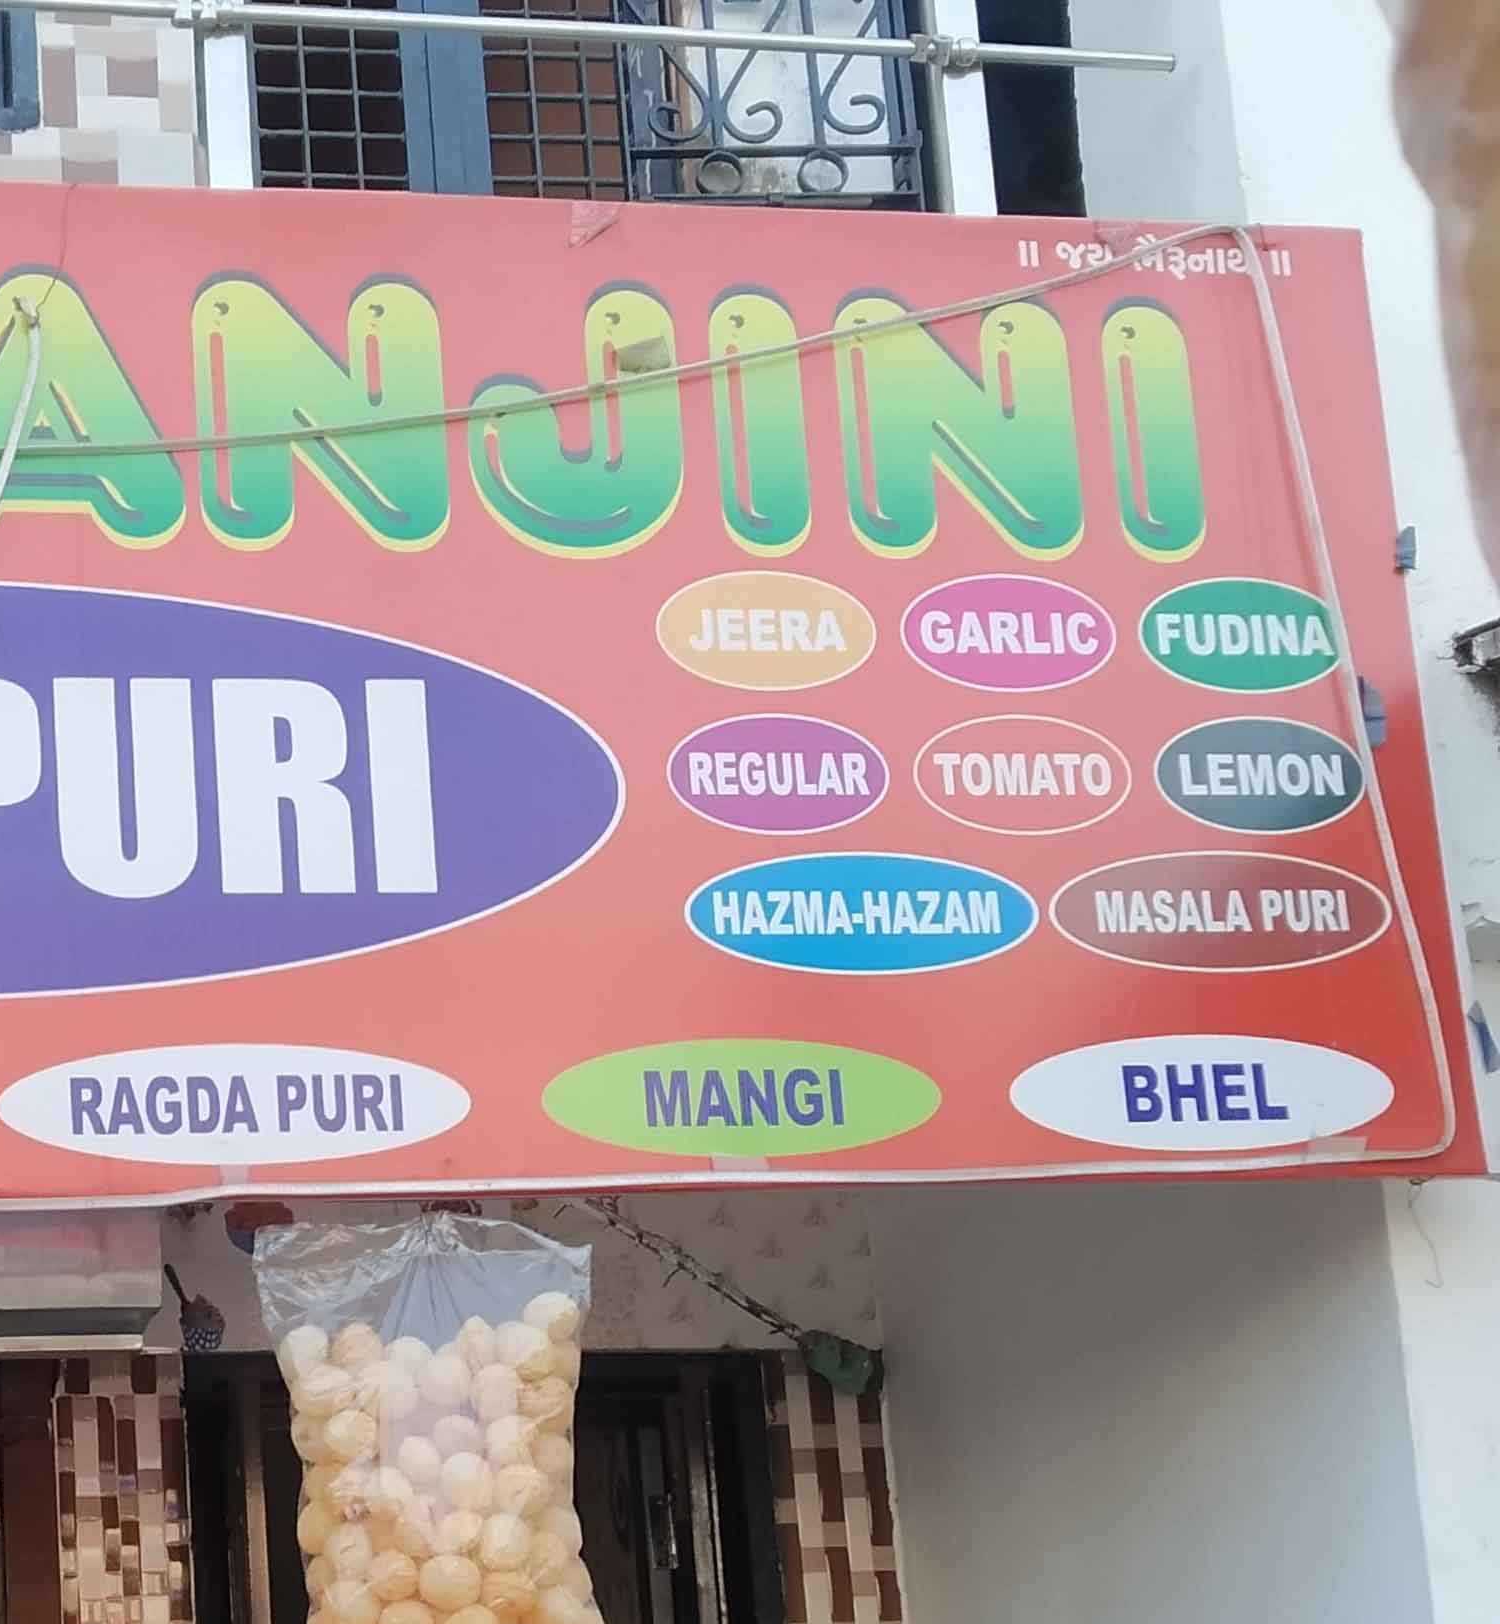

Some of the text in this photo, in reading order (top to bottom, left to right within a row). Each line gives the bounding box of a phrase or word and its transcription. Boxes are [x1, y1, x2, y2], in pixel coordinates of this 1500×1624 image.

[690, 608, 846, 654] JEERA
[919, 610, 1098, 656] GARLIC
[1157, 613, 1335, 657] FUDINA
[689, 751, 870, 798] REGULAR
[933, 751, 1112, 798] TOMATO
[1179, 753, 1345, 798] LEMON
[712, 889, 1001, 936] HAZMA-HAZAM
[1095, 888, 1350, 934] MASALA PURI
[70, 1073, 405, 1136] RAGDA PURI
[643, 1068, 845, 1127] MANGI
[1122, 1064, 1290, 1122] BHEL
